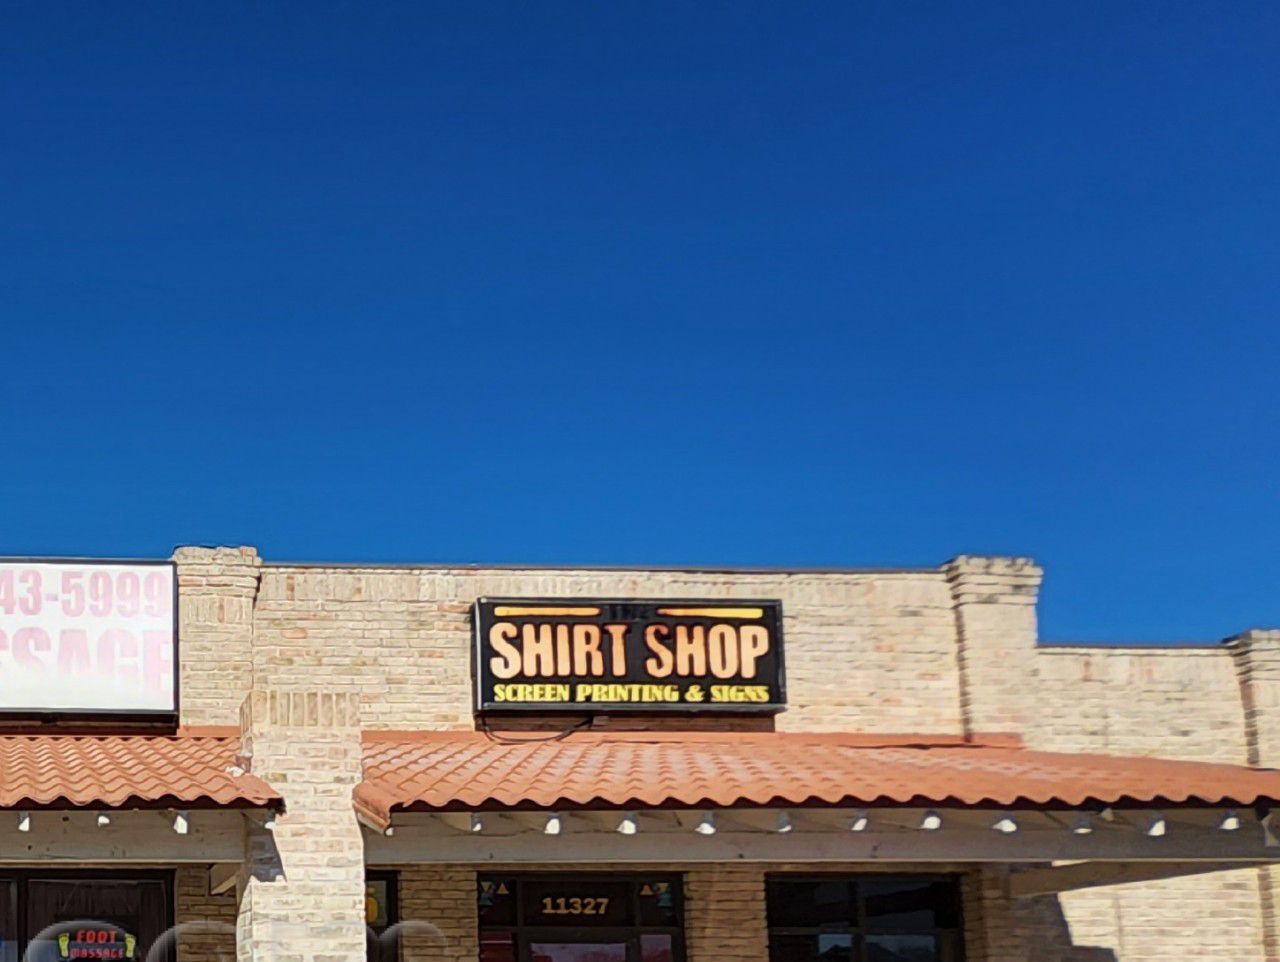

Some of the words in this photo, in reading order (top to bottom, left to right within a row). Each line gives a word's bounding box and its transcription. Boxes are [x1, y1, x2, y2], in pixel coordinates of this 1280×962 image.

[489, 621, 631, 679] SHIRT
[644, 623, 769, 679] SHOP
[493, 683, 570, 702] SCREEN
[576, 684, 679, 702] PRINTING
[685, 685, 705, 702] &
[711, 685, 770, 703] SIGNS
[542, 897, 609, 914] 11327
[76, 930, 117, 944] FOOT
